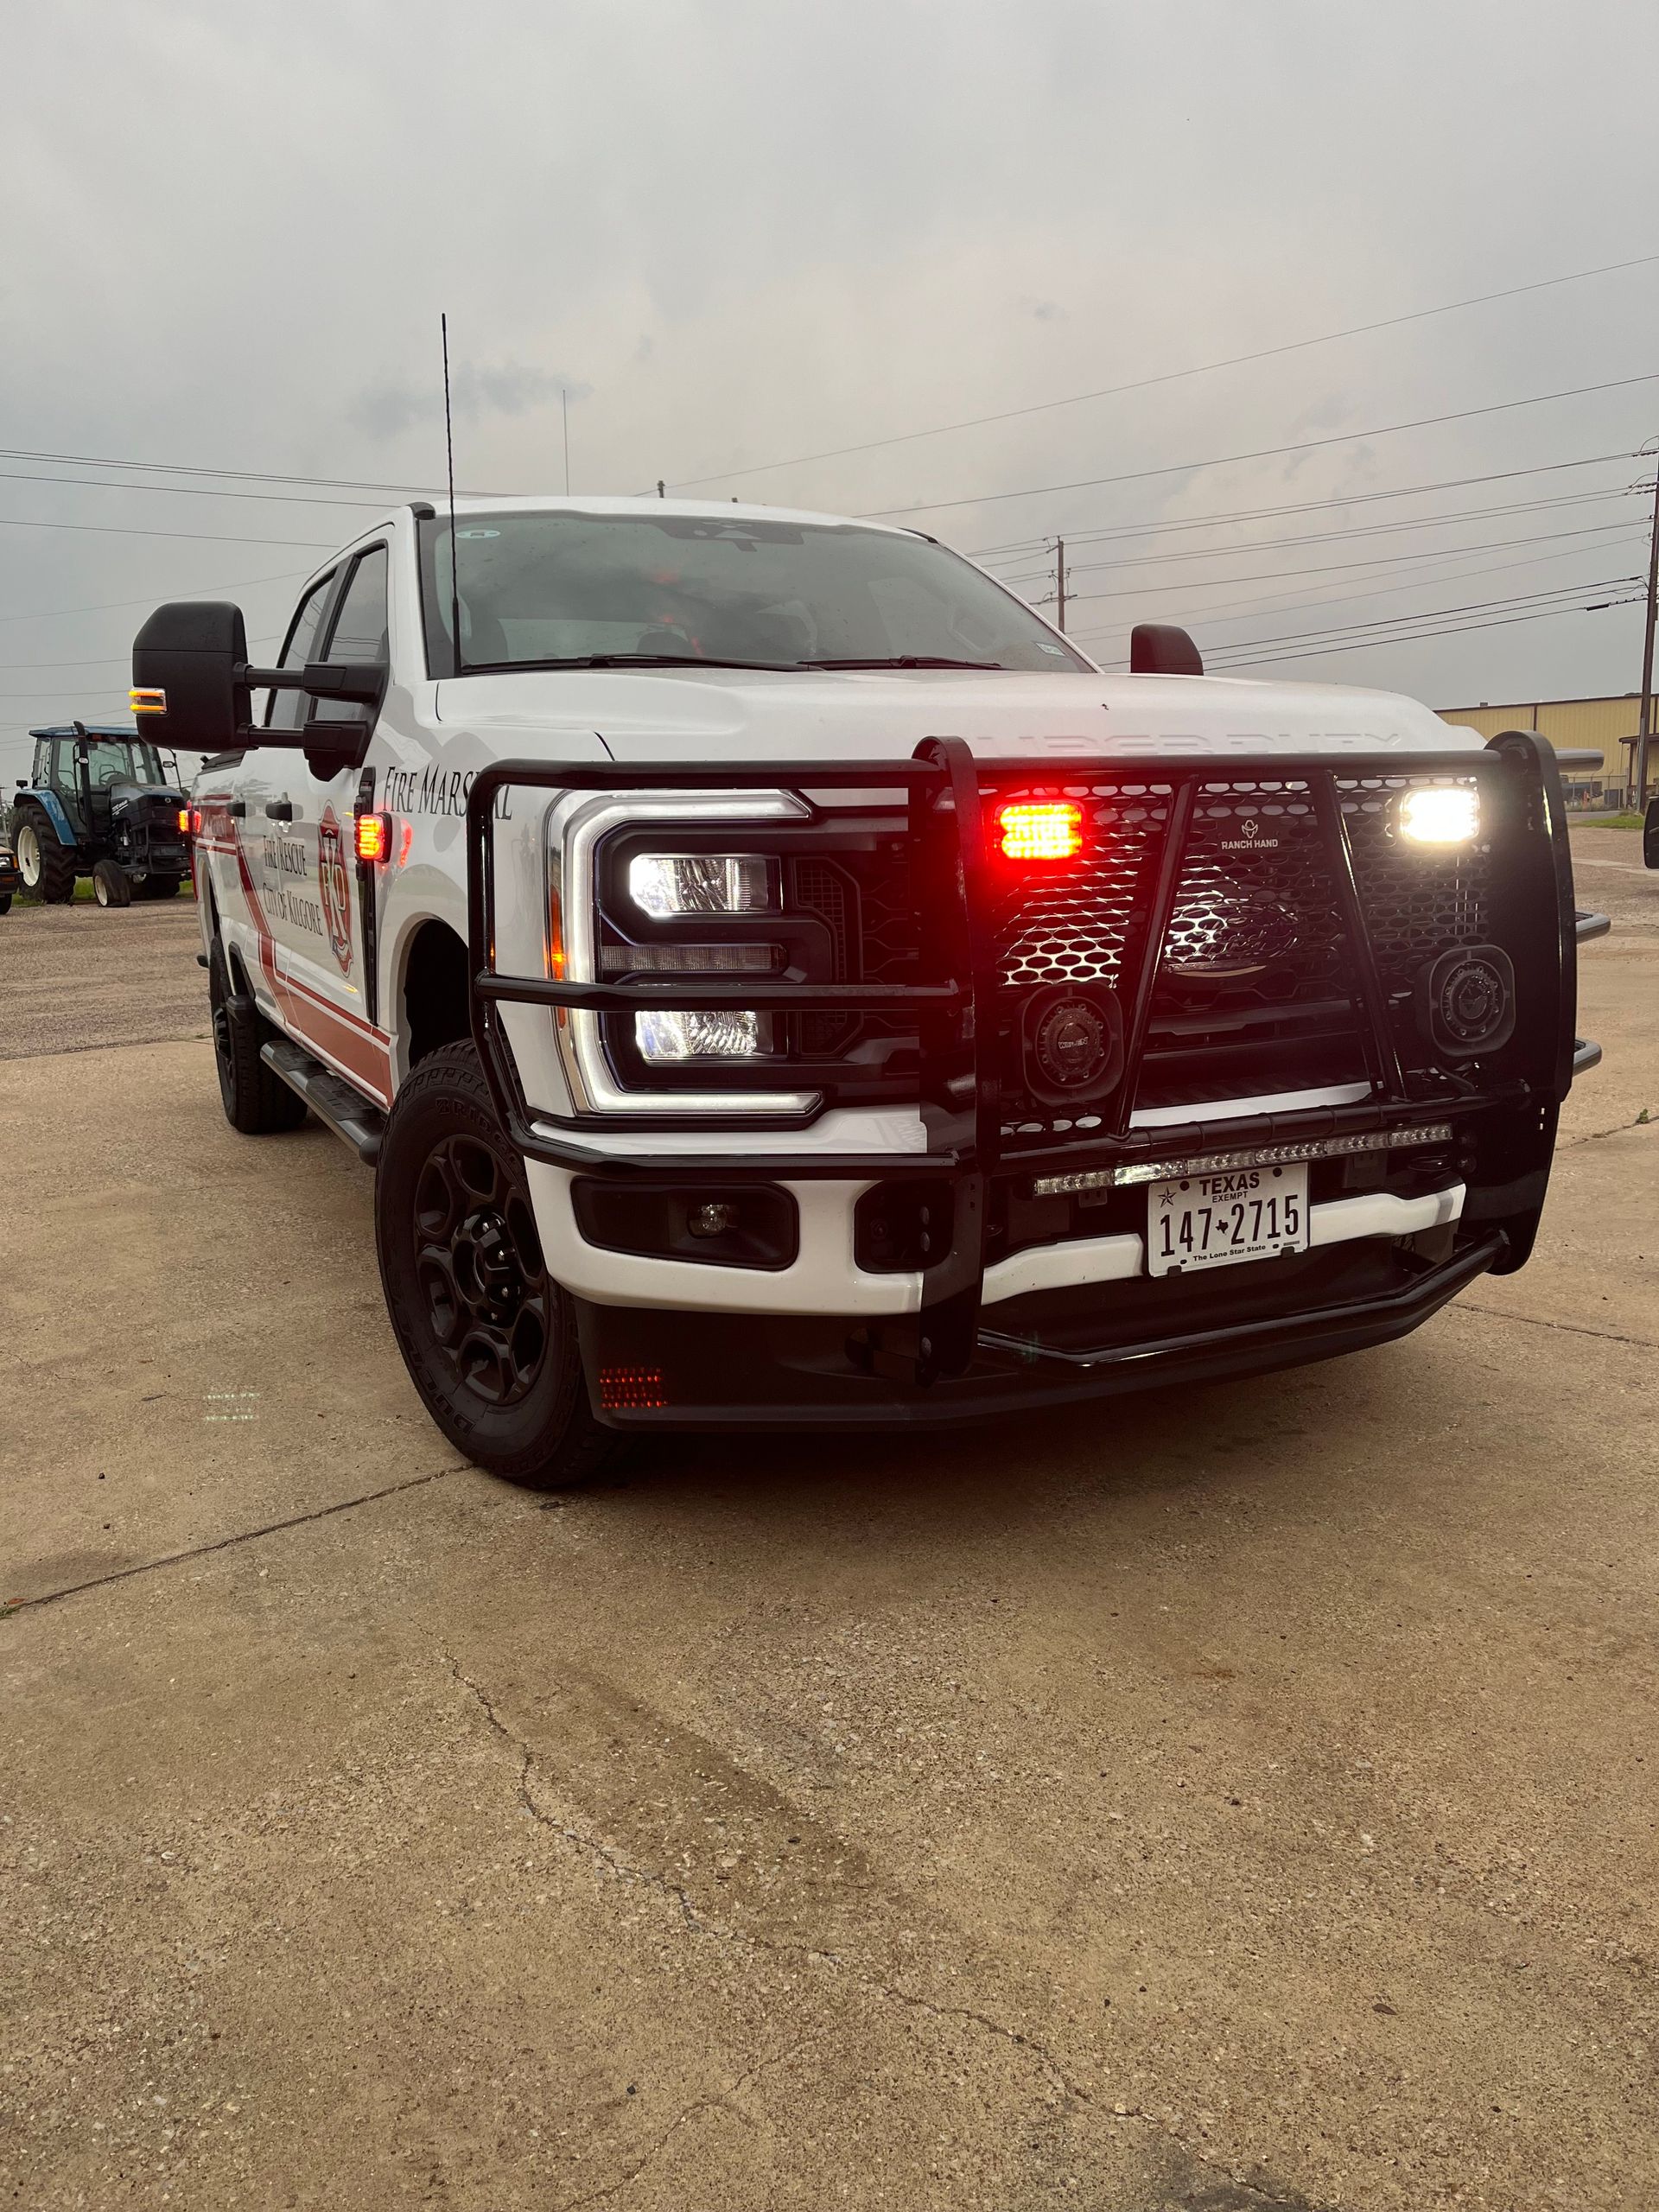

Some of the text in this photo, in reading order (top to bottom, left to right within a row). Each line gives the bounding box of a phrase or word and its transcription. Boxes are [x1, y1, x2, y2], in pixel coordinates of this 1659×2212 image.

[383, 763, 513, 820] FIRE MARSL
[1221, 838, 1279, 850] RANCH HAND
[1199, 1172, 1260, 1196] TEXAS
[1211, 1191, 1249, 1204] EXEMPT
[1209, 1250, 1228, 1260] Lone
[1229, 1248, 1245, 1256] Star
[1246, 1244, 1267, 1253] State
